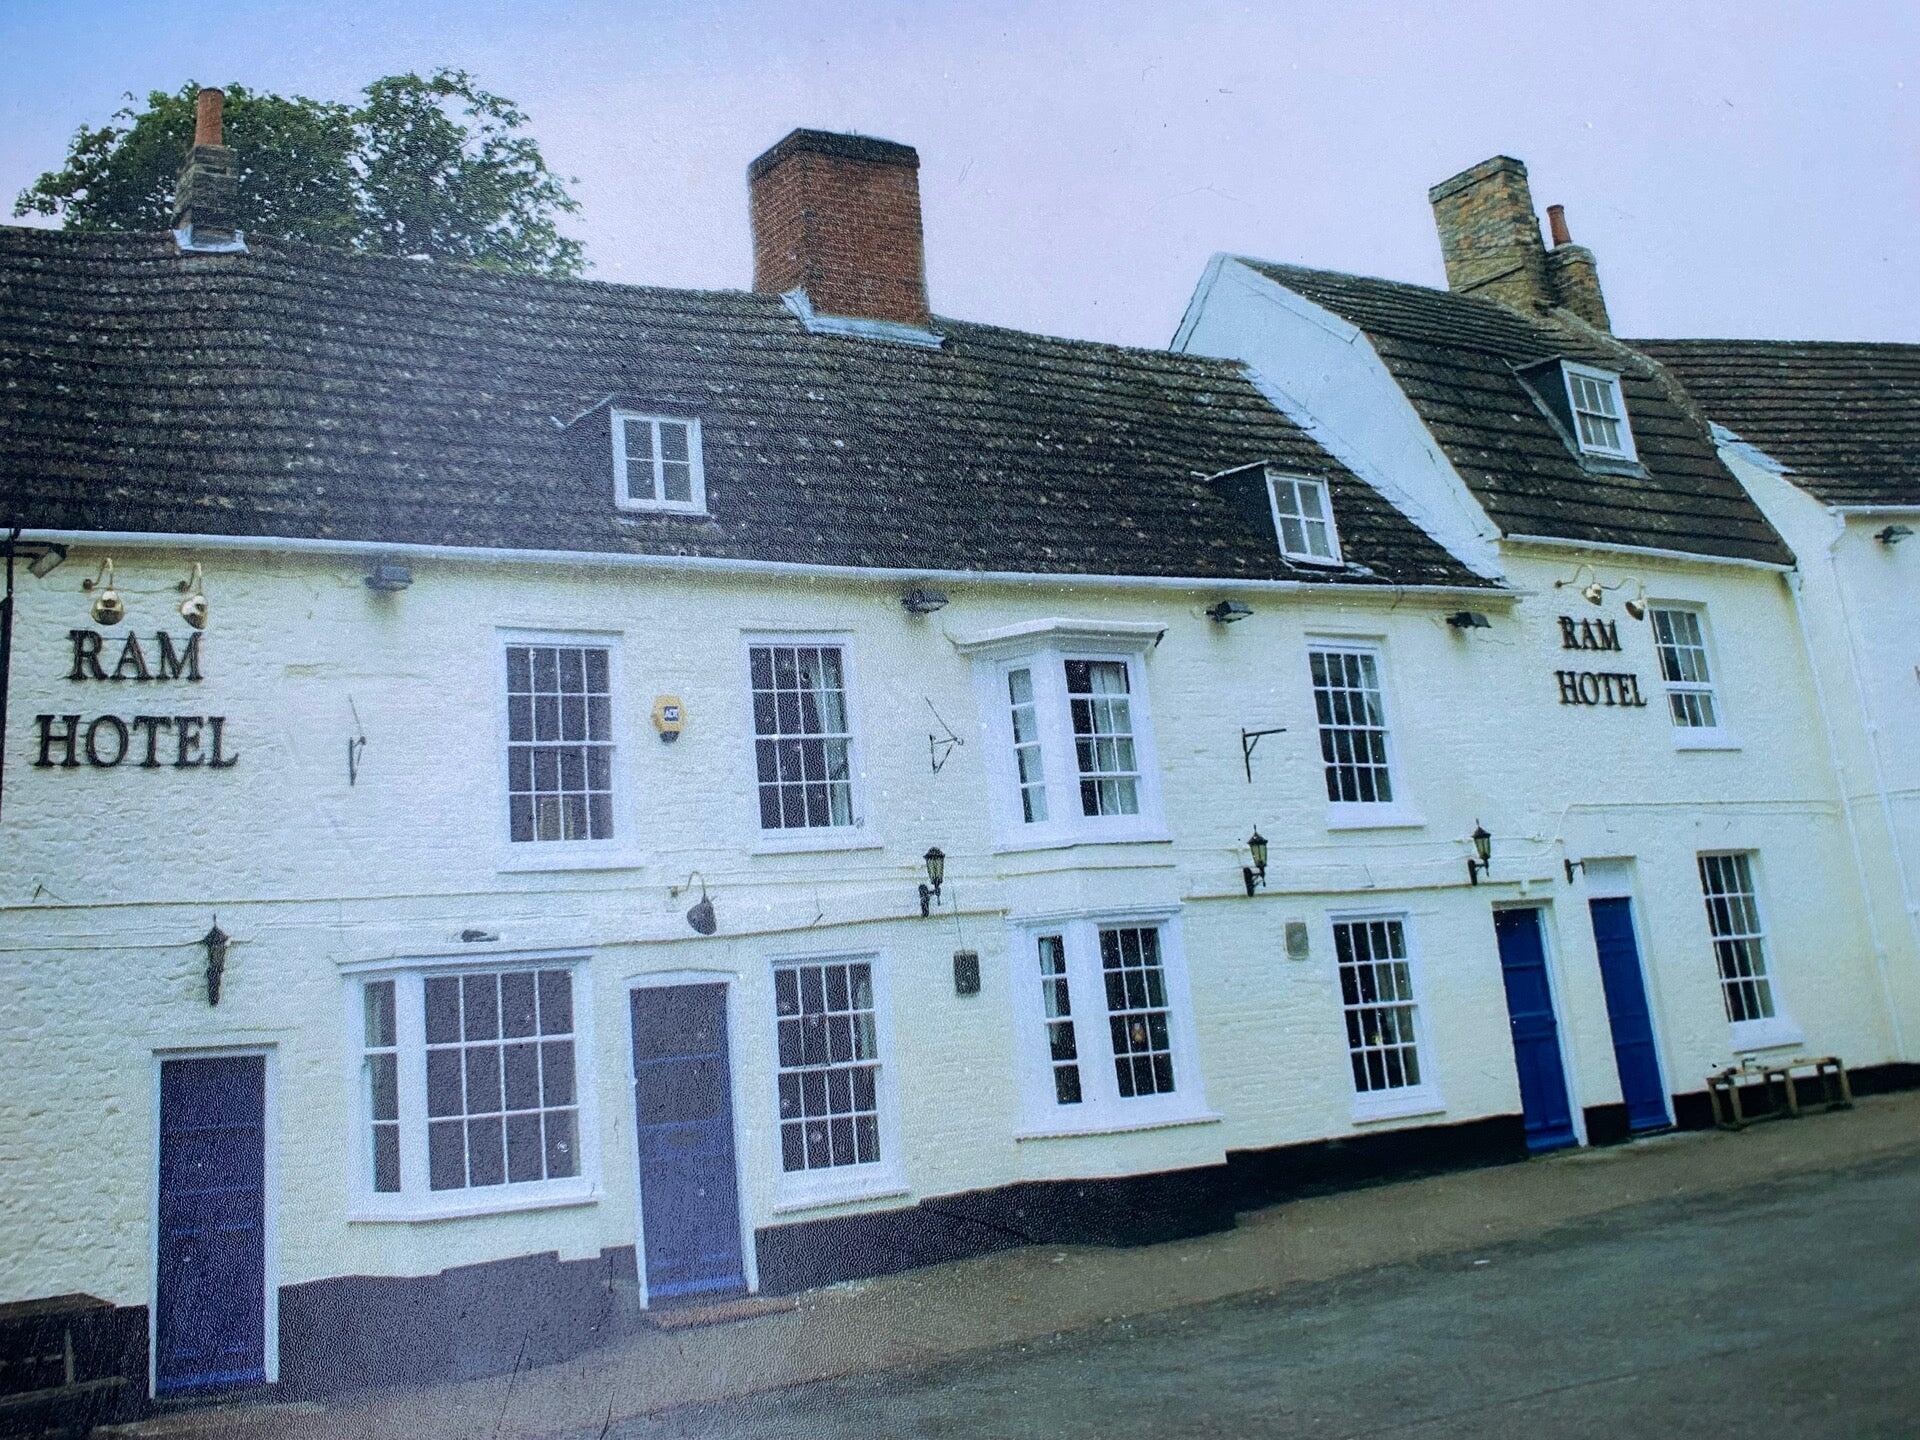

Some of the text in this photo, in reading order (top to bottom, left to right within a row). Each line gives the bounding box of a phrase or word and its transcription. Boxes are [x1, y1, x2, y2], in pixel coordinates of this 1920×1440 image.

[67, 629, 204, 681] RAM
[1558, 615, 1622, 651] RAM
[1553, 669, 1647, 707] HOTEL
[34, 714, 239, 768] HOTEL
